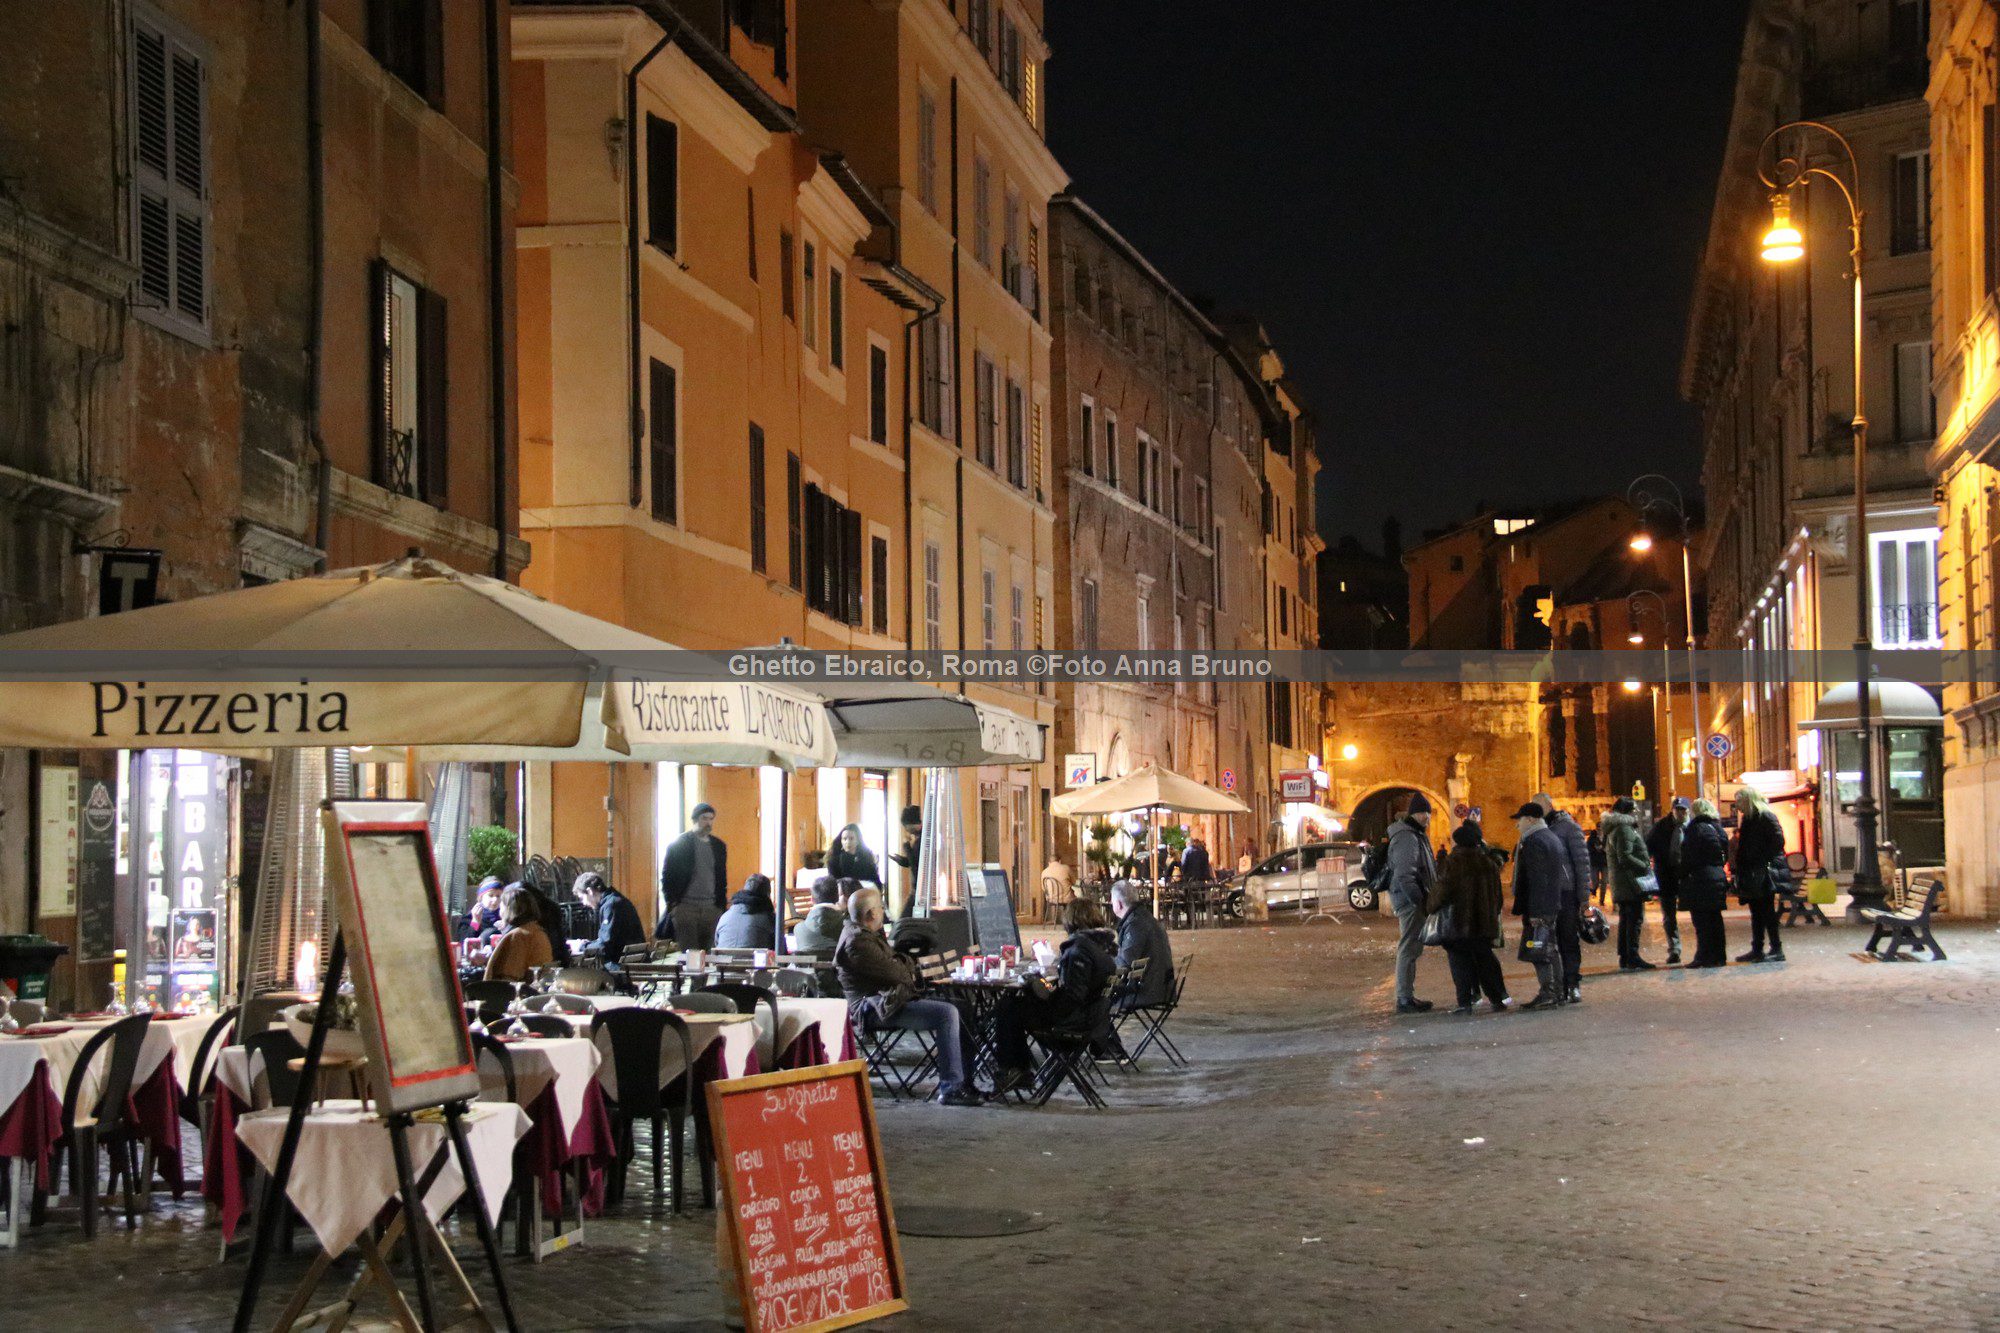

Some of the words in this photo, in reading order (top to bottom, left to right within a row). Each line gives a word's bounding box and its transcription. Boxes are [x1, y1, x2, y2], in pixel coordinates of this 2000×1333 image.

[90, 678, 349, 737] Pizzeria
[631, 676, 730, 732] Ristorante
[1287, 783, 1306, 791] WiFi
[181, 802, 206, 908] BAR
[833, 1131, 863, 1151] MENU
[846, 1151, 855, 1172] 3
[748, 1174, 757, 1198] 1
